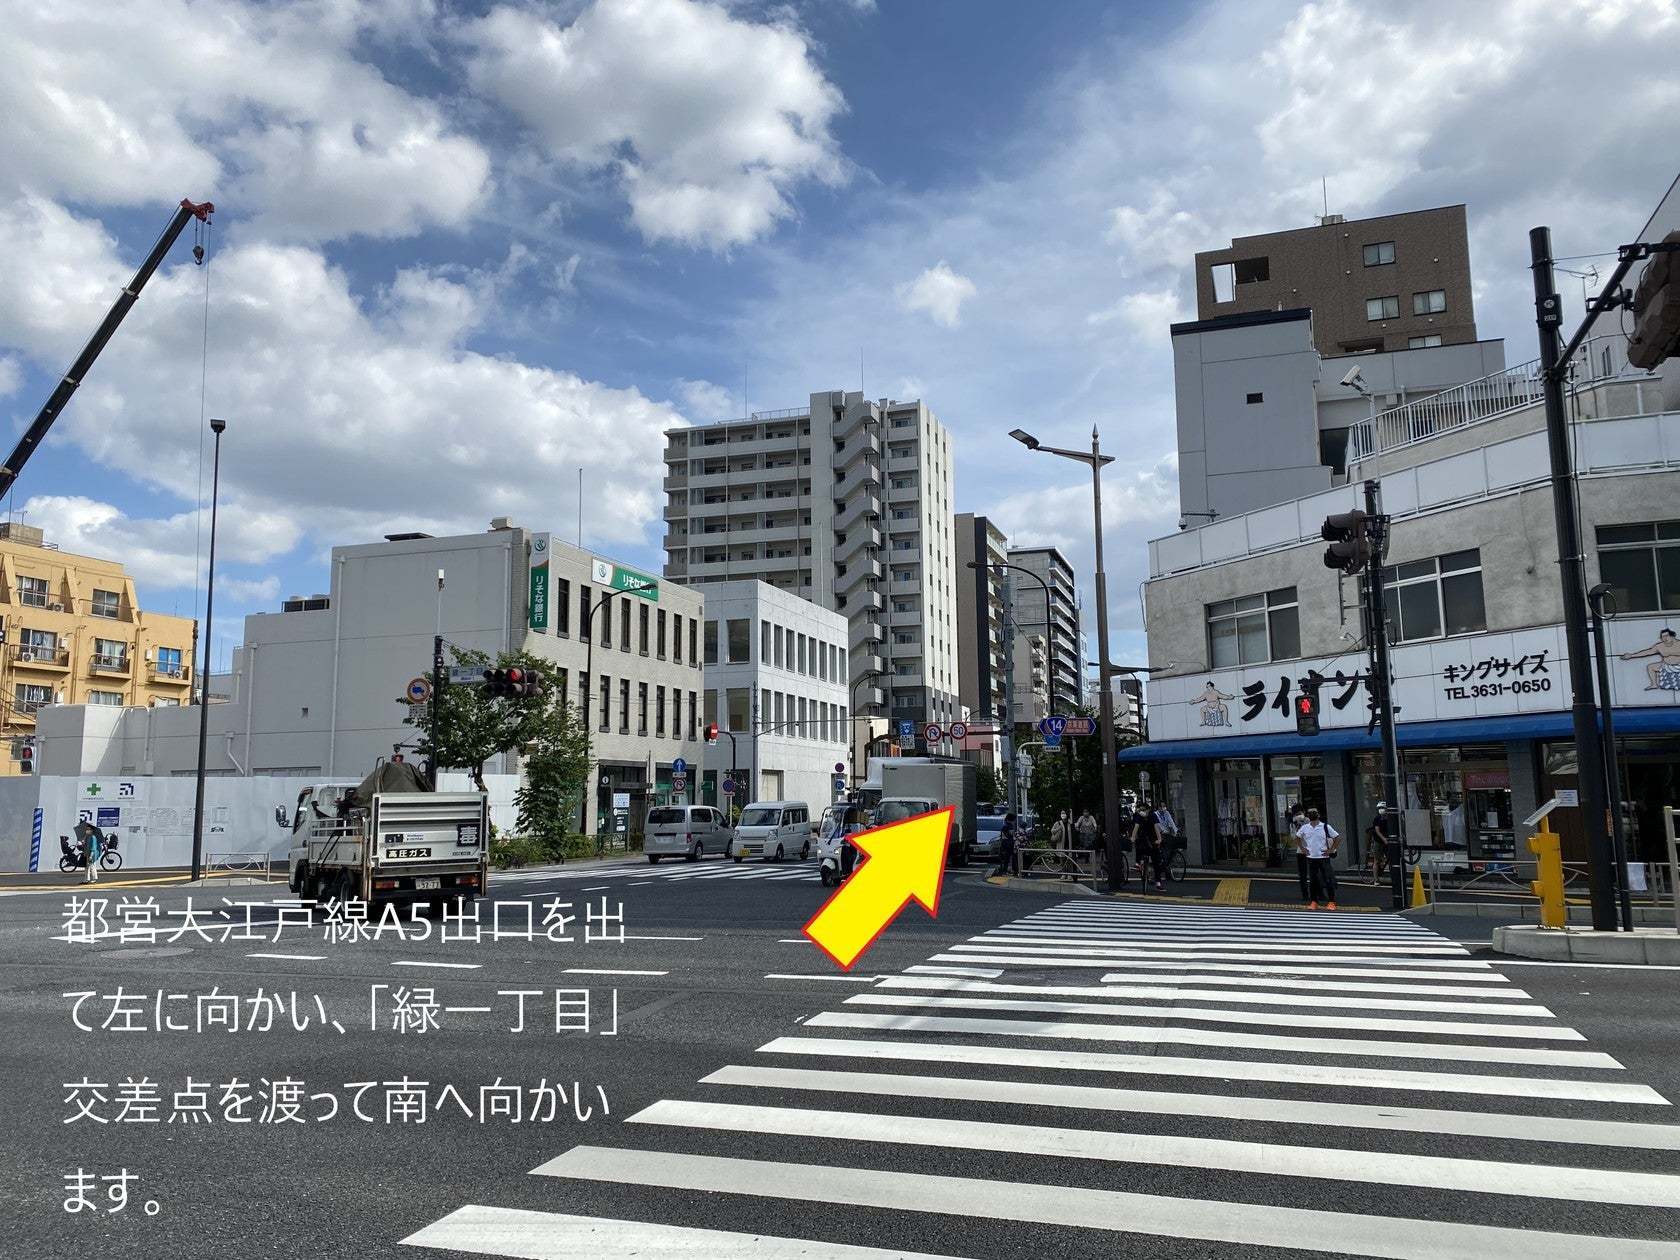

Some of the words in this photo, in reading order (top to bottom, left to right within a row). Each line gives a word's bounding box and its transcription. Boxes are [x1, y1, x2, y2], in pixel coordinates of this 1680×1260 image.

[535, 575, 545, 622] りそな銀行
[1443, 649, 1549, 683] キングサイズ
[953, 726, 963, 735] 50
[1051, 720, 1063, 731] 14
[388, 849, 428, 858] 高圧ガス
